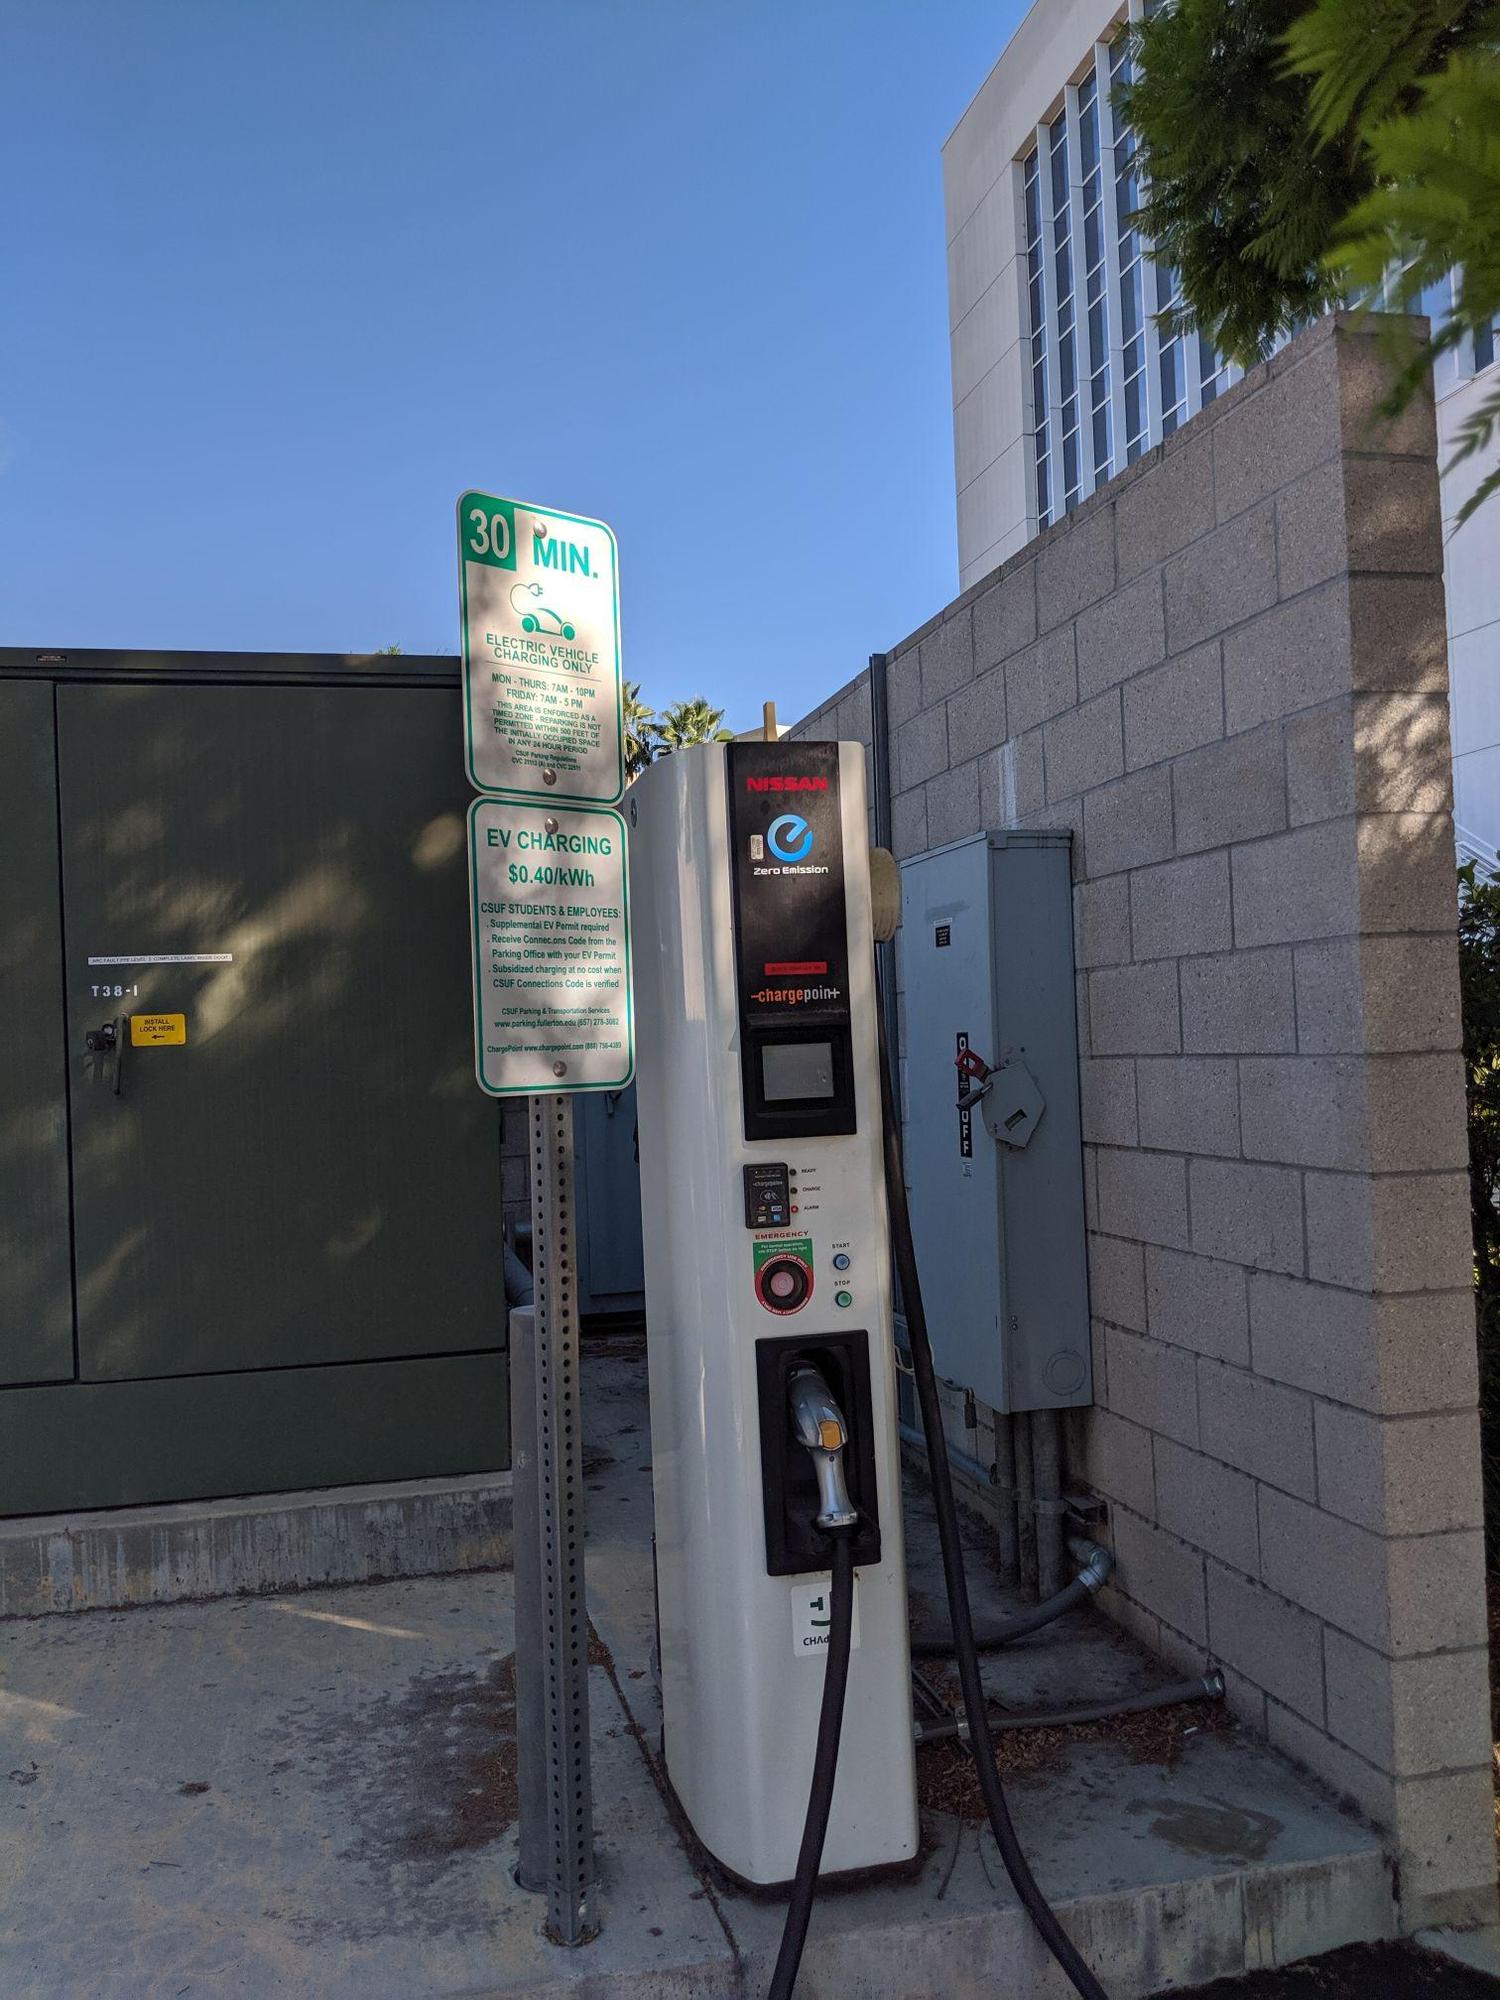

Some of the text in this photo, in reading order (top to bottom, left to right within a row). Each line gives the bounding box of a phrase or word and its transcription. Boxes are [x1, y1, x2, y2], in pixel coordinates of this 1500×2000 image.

[470, 508, 598, 578] 30 MIN.
[486, 634, 599, 664] ELECTRIC VEHICLE
[494, 648, 592, 674] CHARGING ONLY
[492, 672, 511, 685] MON
[520, 678, 549, 690] THURS:
[552, 682, 568, 694] 7AM
[576, 687, 595, 698] 10PM
[507, 689, 538, 702] FRIDAY:
[540, 694, 557, 705] 7AM
[564, 698, 569, 706] 5
[571, 699, 583, 709] PM
[492, 709, 513, 717] TIMED
[540, 716, 578, 727] REPARKING
[514, 704, 533, 712] AREA
[543, 708, 579, 719] ENFORCED
[494, 718, 533, 729] PERMITTED
[535, 723, 558, 732] WITHIN
[494, 726, 600, 747] THE INITIALLY OCCUPIED SPACE
[517, 738, 531, 746] ANY
[542, 742, 561, 750] HOUR
[563, 745, 588, 754] PERIOD
[747, 777, 828, 791] NISSAN
[487, 828, 612, 855] EV CHARGING
[508, 864, 594, 887] $0.40/kWh
[754, 865, 828, 875] Zero Emission
[481, 902, 621, 918] CSUF STUDENTS & EMPLOYEES:
[490, 919, 609, 932] Supplemental EV Permit required
[492, 934, 522, 944] Receive
[568, 935, 586, 945] Code
[588, 936, 604, 946] from
[605, 936, 616, 946] the
[492, 950, 522, 960] Parking
[524, 950, 545, 959] Office
[547, 950, 562, 958] with
[492, 964, 534, 973] Subsidized
[535, 965, 566, 975] charging
[493, 979, 515, 988] CSUF
[517, 979, 563, 988] Connections
[565, 979, 584, 988] Code
[594, 979, 620, 988] verified
[520, 1008, 541, 1016] Parking
[494, 1019, 576, 1028] www.parking.fullerton.edu
[487, 1045, 523, 1054] ChargePoint
[524, 1043, 584, 1052] www.chargepoint.com
[756, 1230, 808, 1239] EMERGENCY
